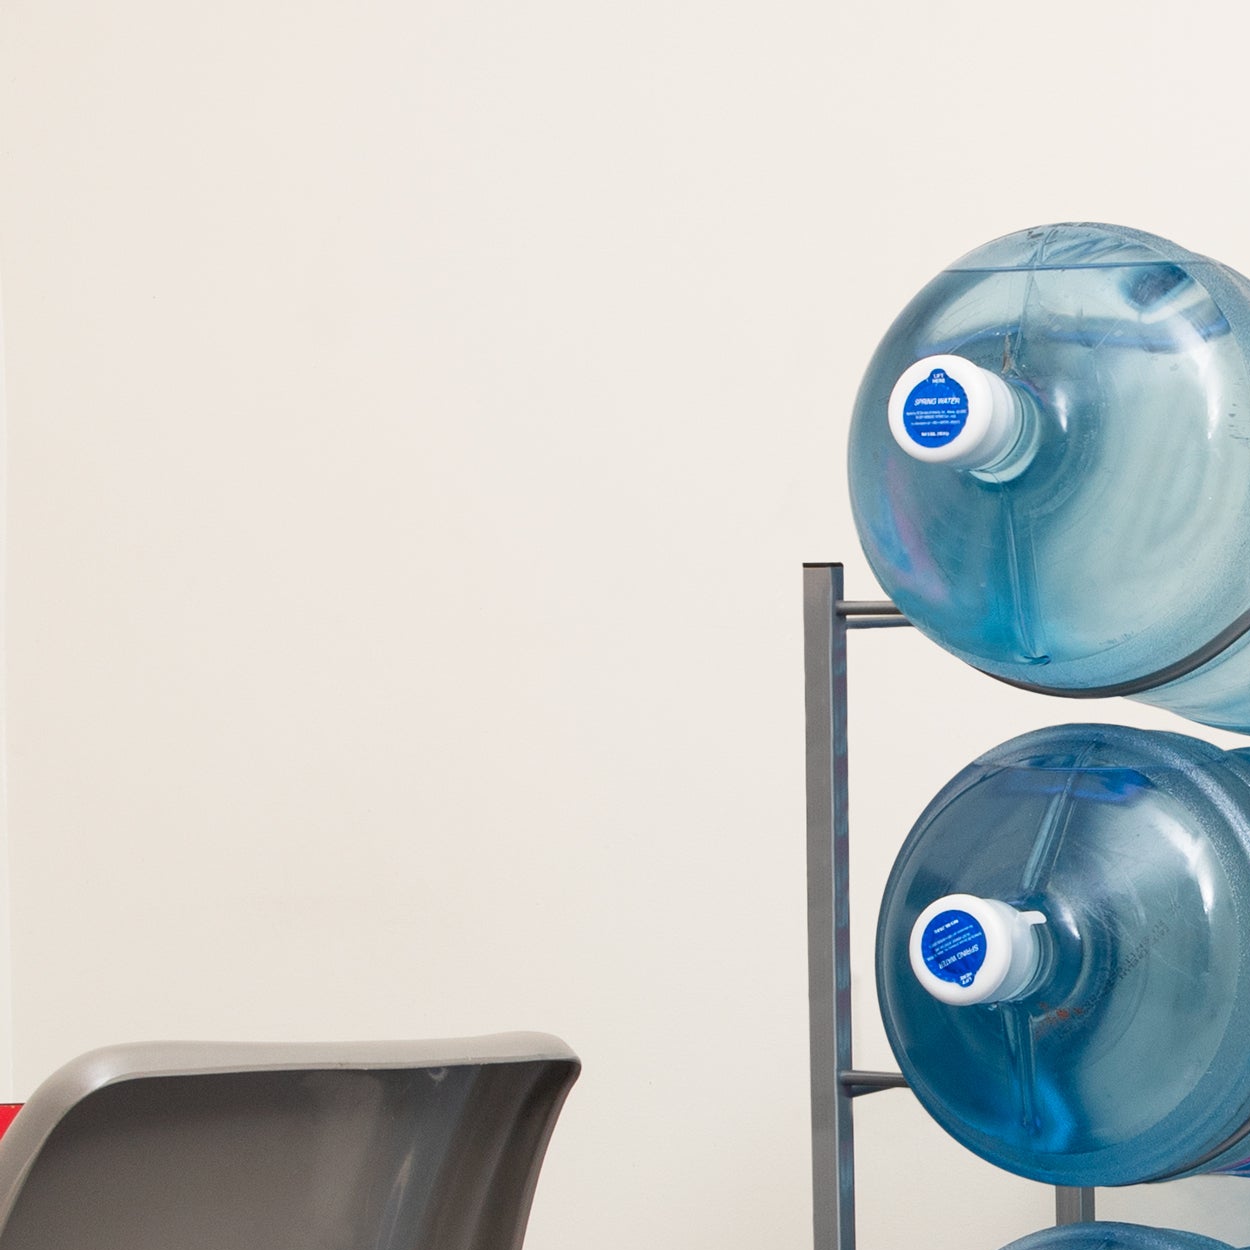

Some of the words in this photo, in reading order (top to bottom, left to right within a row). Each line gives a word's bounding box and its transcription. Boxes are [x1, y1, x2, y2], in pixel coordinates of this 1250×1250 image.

[914, 397, 937, 407] SPRING
[938, 397, 961, 406] WATER
[957, 943, 979, 960] SPRING
[939, 954, 957, 970] WATER
